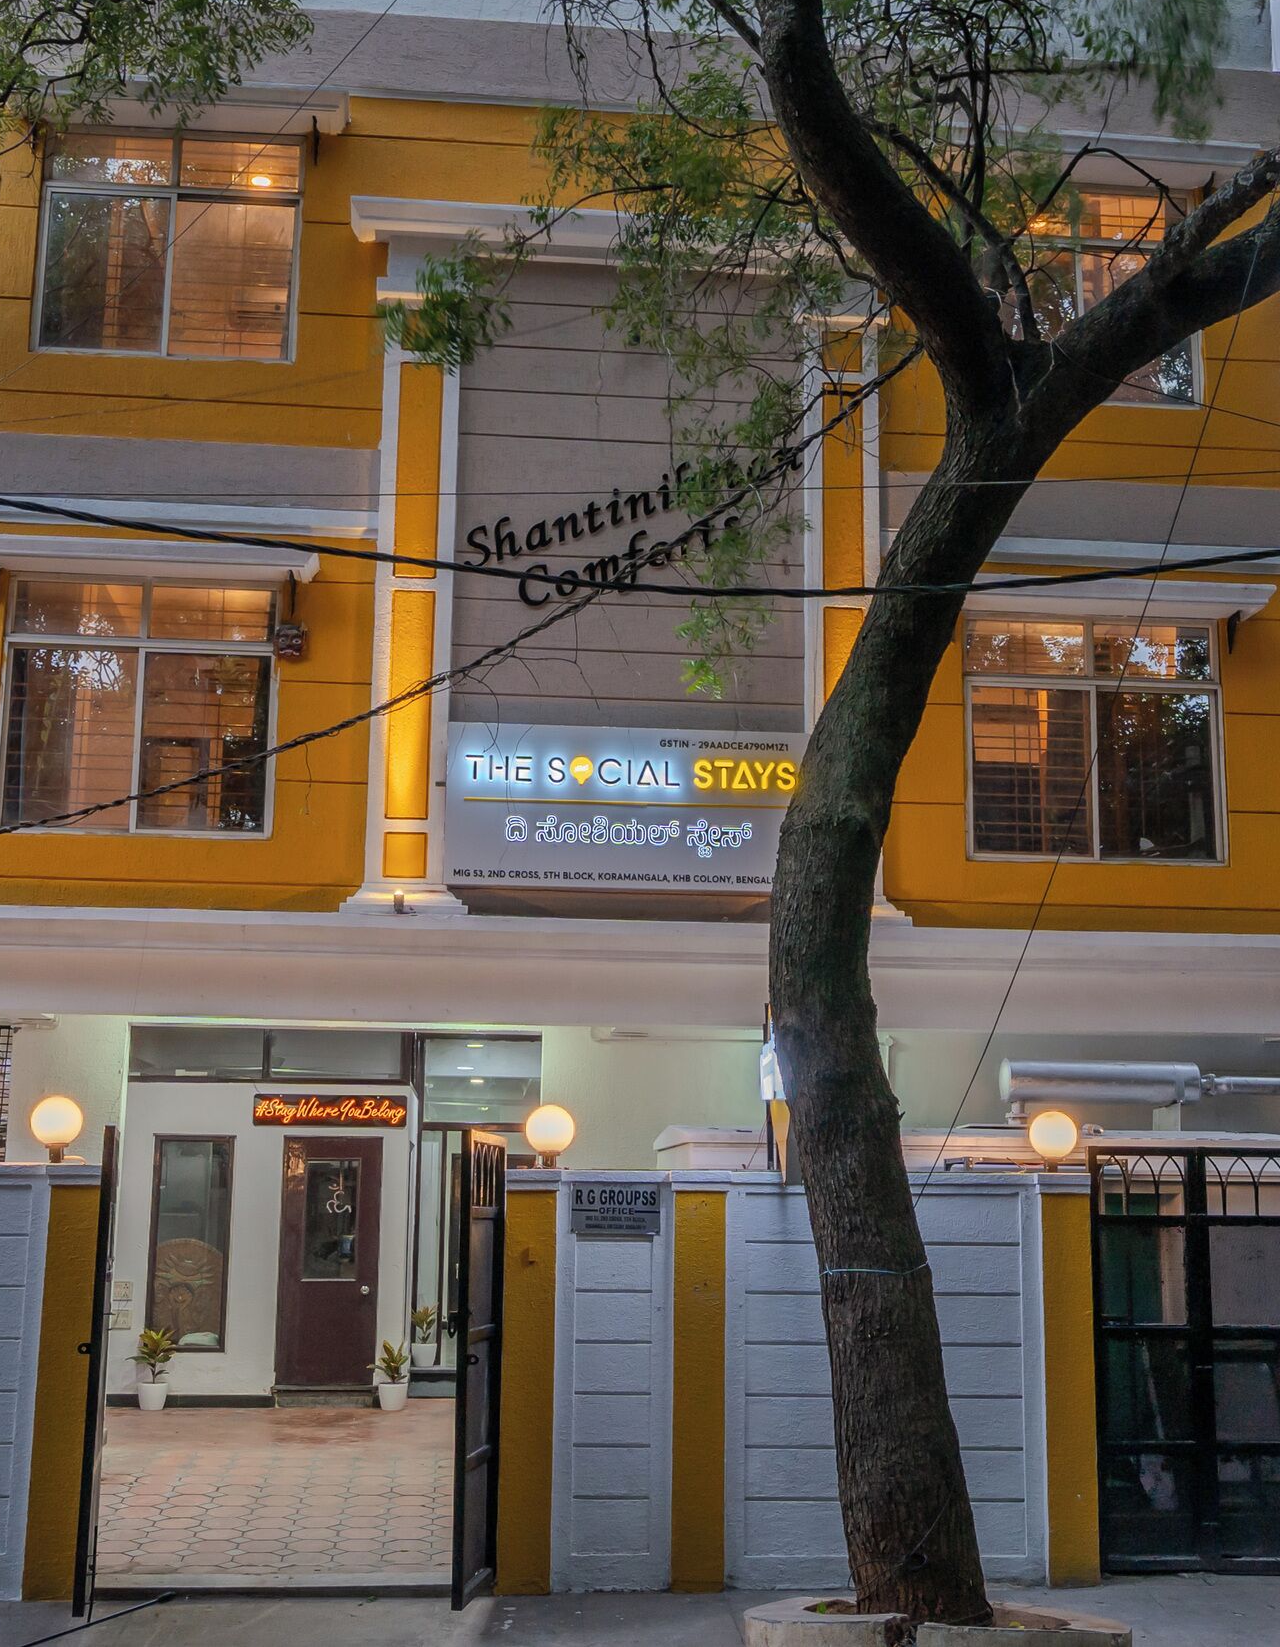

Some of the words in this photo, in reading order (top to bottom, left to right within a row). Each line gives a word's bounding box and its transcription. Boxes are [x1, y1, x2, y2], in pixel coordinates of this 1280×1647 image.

[659, 739, 689, 748] GSTIN
[698, 740, 789, 752] 29AADCE4790M1Z1
[464, 754, 533, 783] THE
[693, 758, 797, 791] STAYS
[505, 815, 528, 842] ದಿ
[453, 869, 471, 877] MIG
[473, 869, 486, 879] 53,
[487, 870, 507, 878] 2ND
[508, 870, 541, 880] CROSS,
[543, 871, 561, 879] 5TH
[563, 872, 596, 881] BLOCK,
[597, 872, 671, 883] KORAMANGALA,
[673, 874, 691, 883] KHB
[693, 875, 734, 885] COLONY,
[575, 1189, 583, 1204] R
[587, 1189, 596, 1205] G
[599, 1189, 657, 1206] GROUPSS
[599, 1207, 635, 1215] OFFICE
